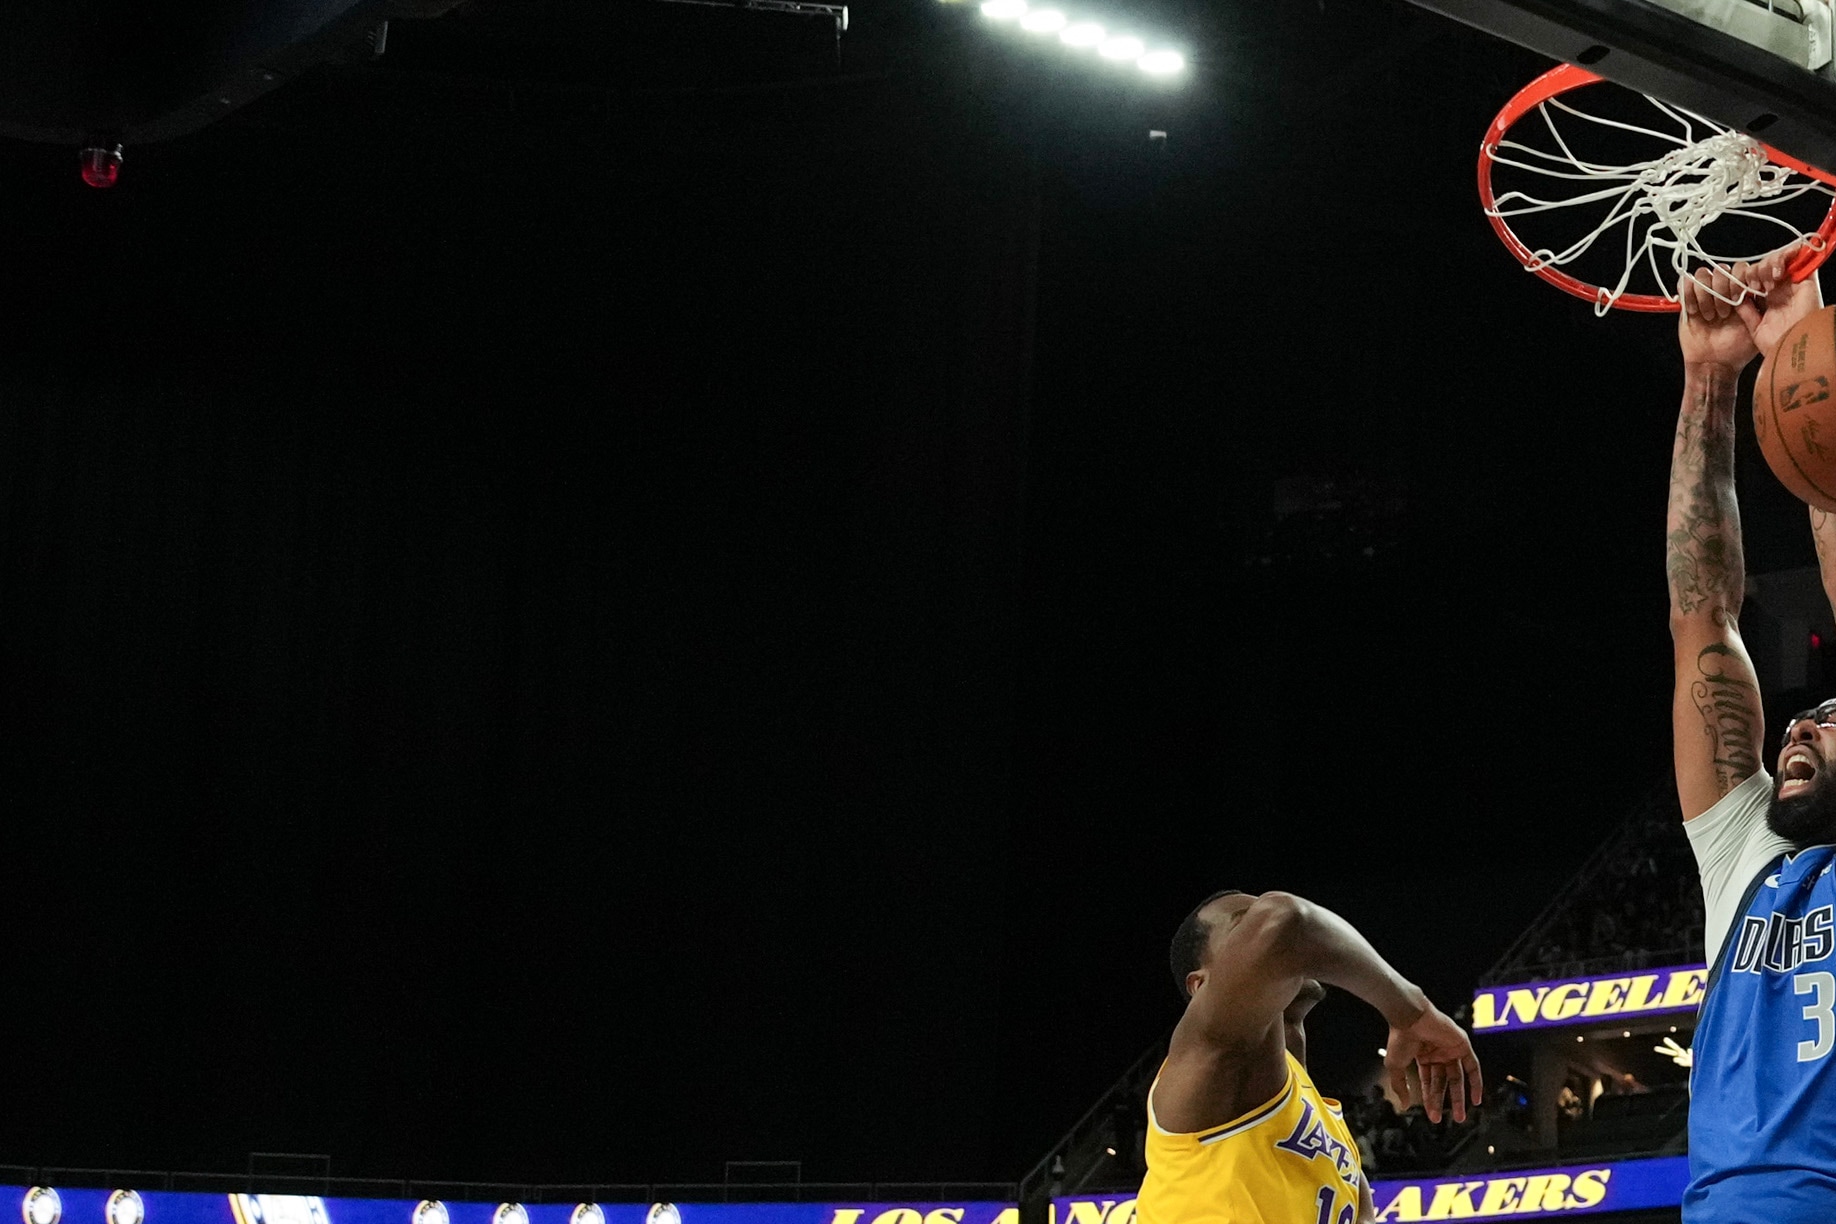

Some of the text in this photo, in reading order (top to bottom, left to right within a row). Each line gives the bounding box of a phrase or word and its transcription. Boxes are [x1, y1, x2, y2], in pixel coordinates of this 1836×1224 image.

[1472, 968, 1709, 1028] ANGELE
[1793, 970, 1836, 1063] 3
[1373, 1169, 1611, 1224] AKERS
